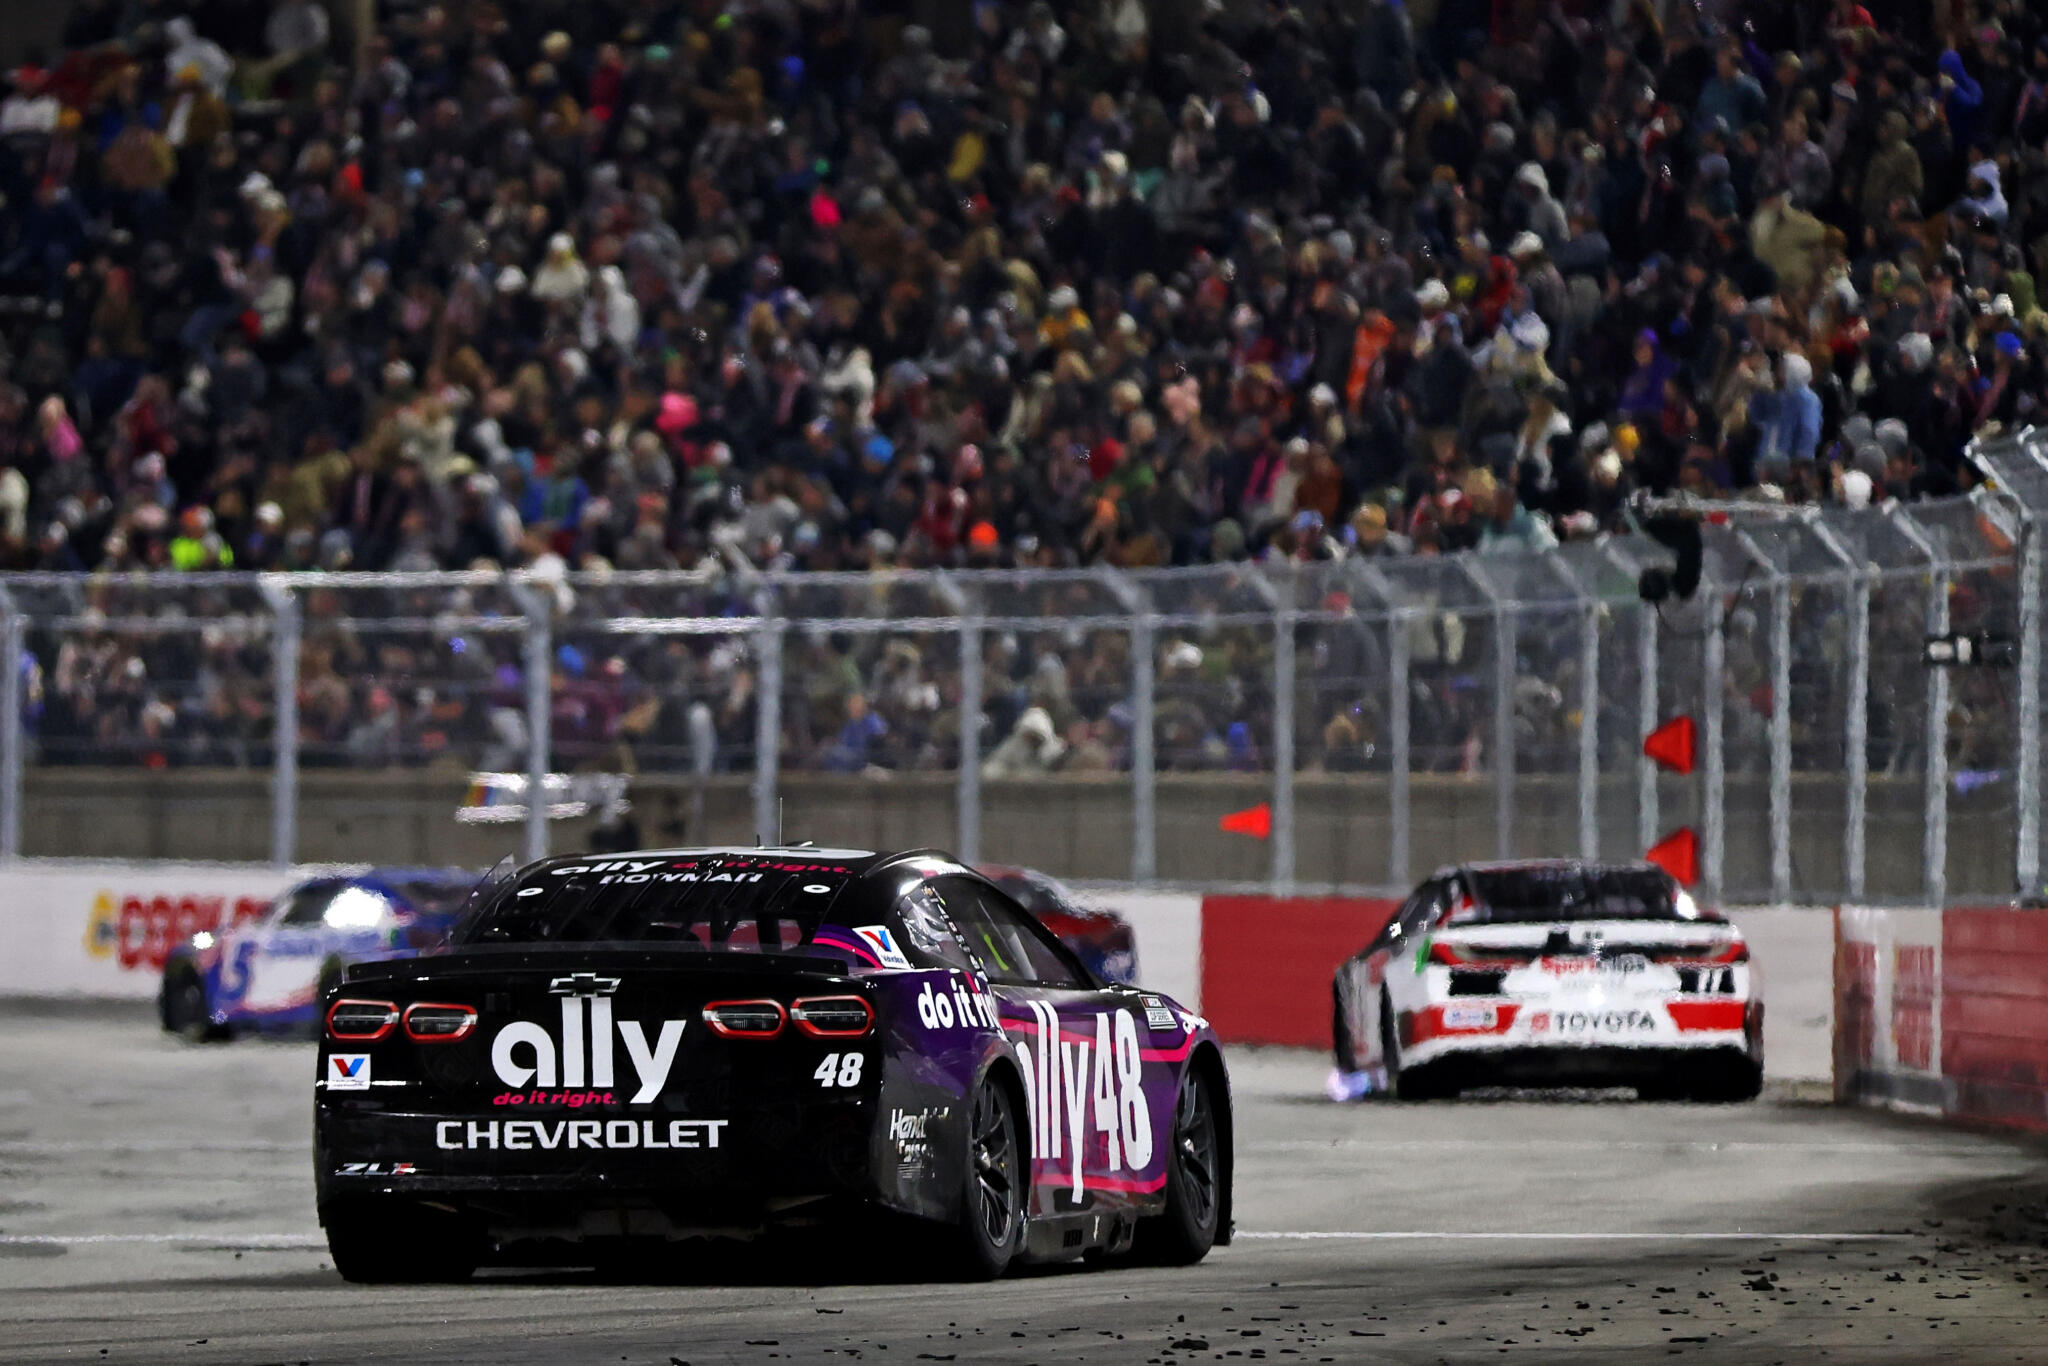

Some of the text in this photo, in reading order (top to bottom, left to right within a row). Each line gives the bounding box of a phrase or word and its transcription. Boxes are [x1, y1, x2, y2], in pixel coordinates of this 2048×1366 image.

[551, 860, 667, 875] ally
[918, 982, 954, 1030] do
[950, 977, 978, 1028] it
[1555, 1009, 1656, 1033] TOYOTA
[492, 996, 687, 1104] ally
[813, 1052, 864, 1087] 48
[493, 1089, 617, 1108] do it right.
[436, 1119, 729, 1150] CHEVROLET
